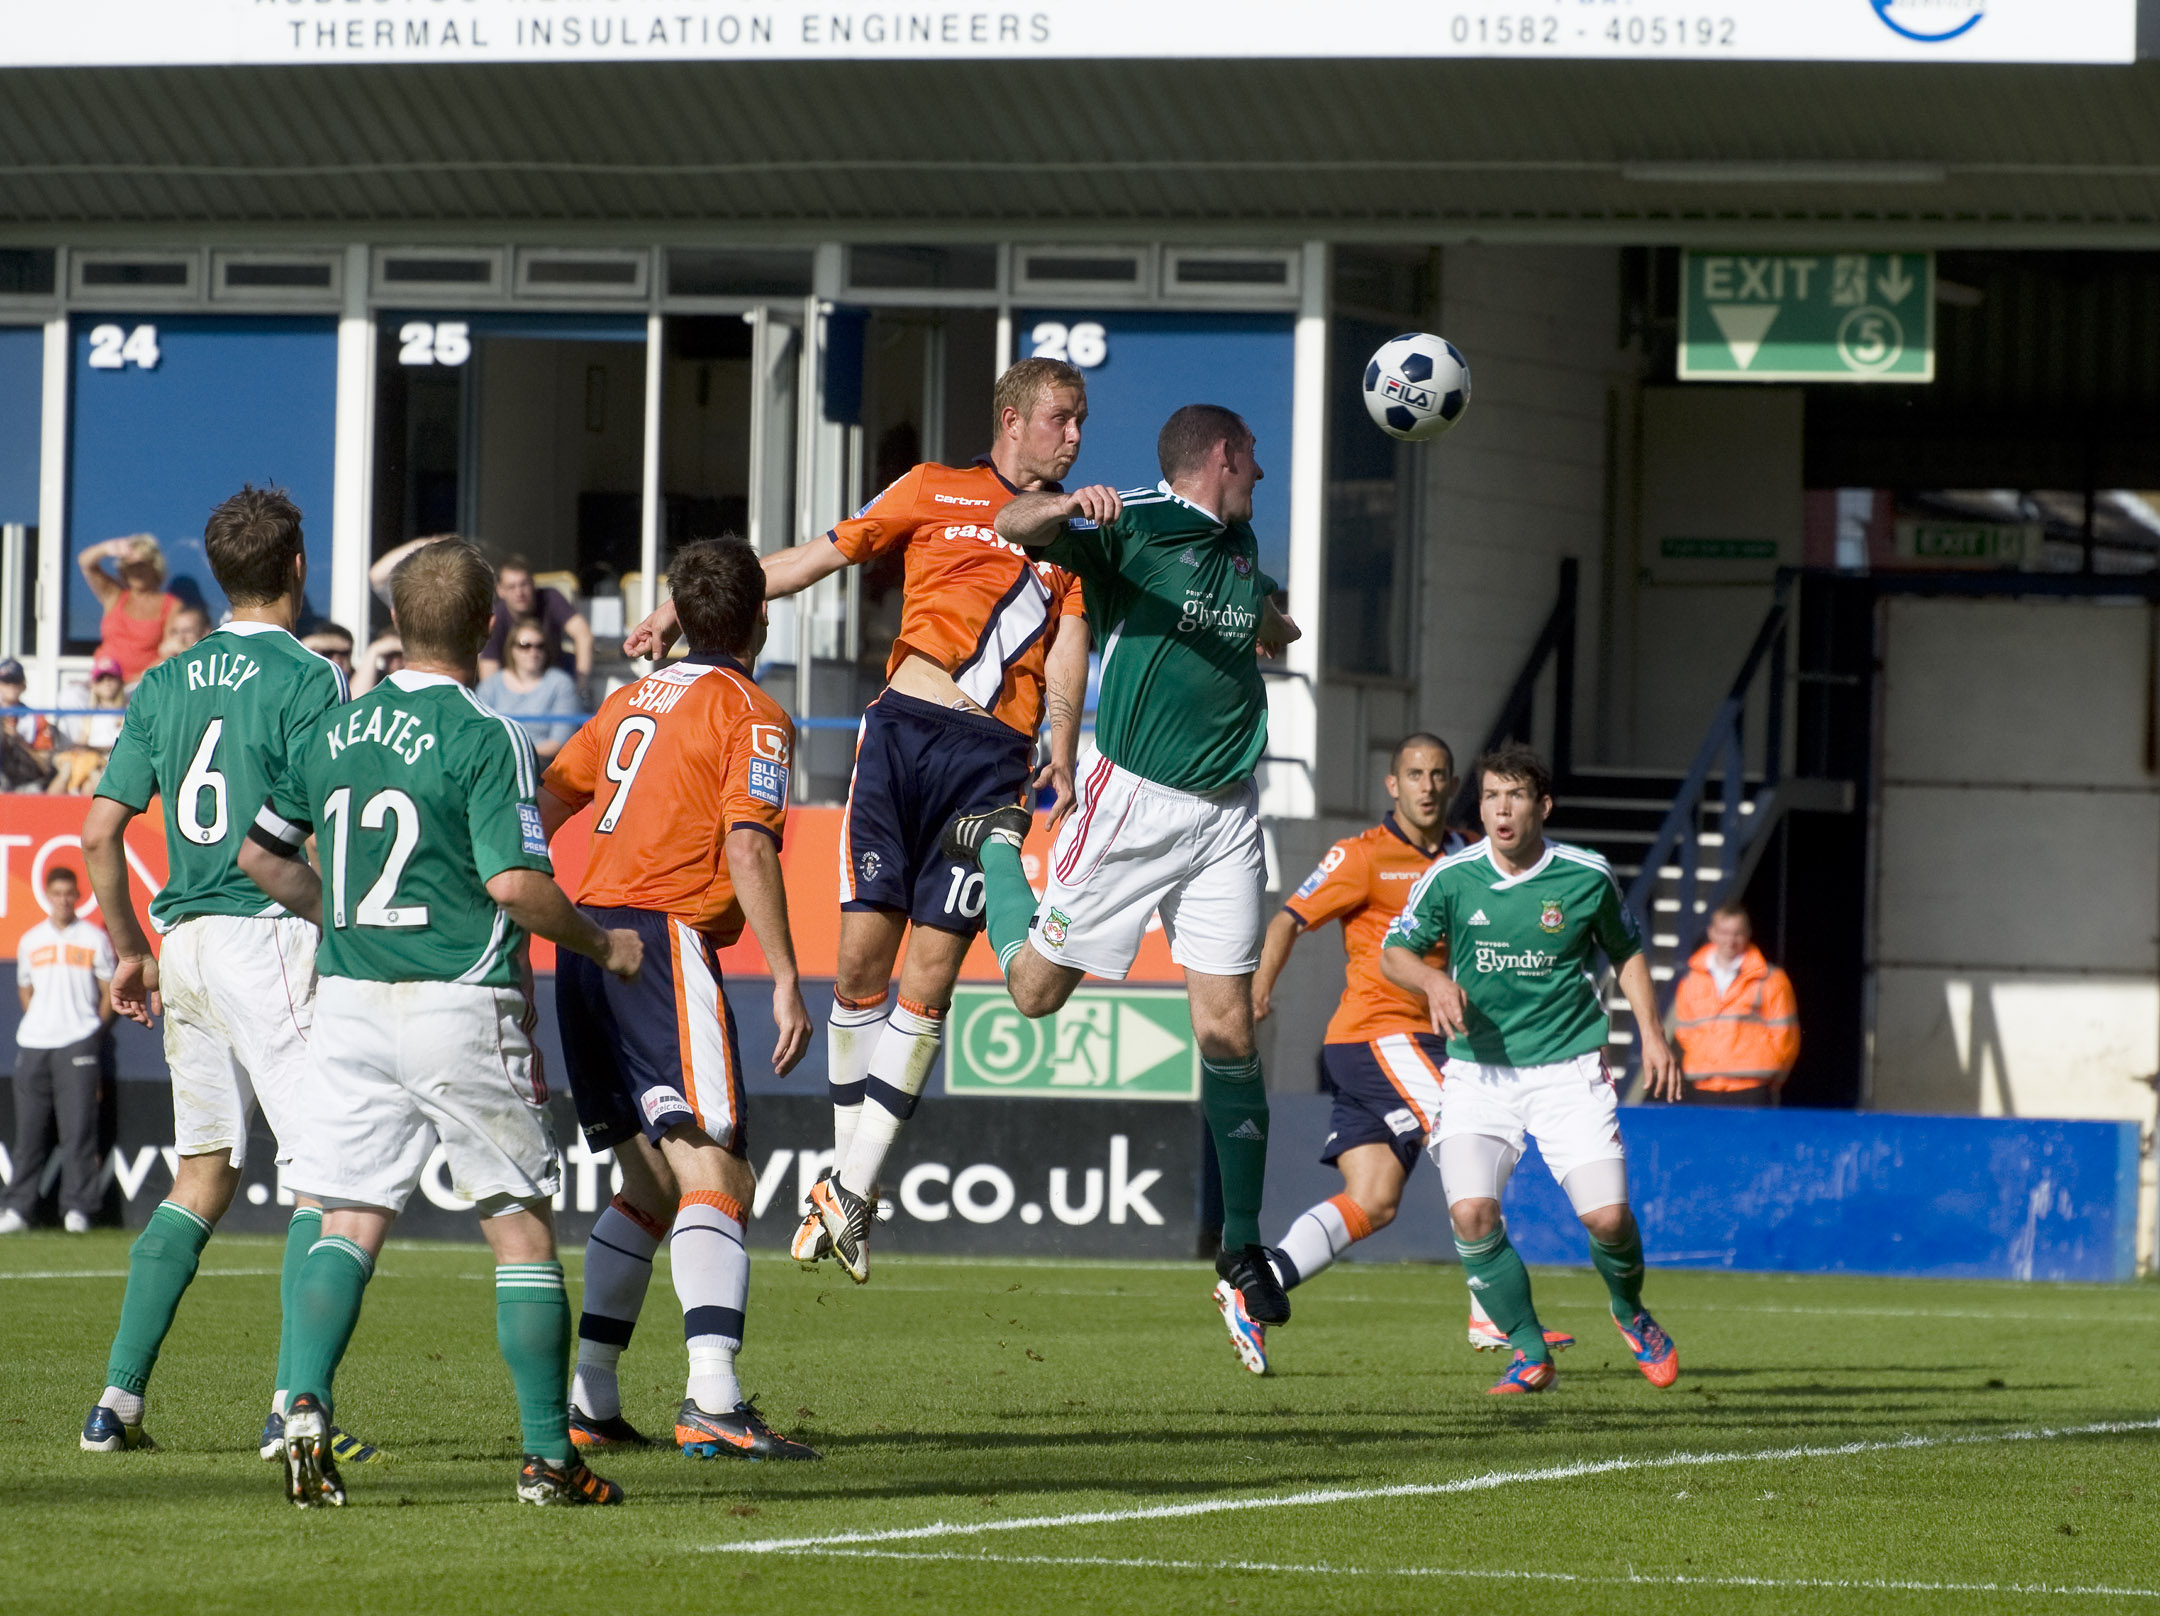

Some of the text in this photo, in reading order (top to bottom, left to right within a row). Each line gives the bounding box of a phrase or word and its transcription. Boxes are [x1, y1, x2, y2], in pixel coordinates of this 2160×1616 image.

[288, 14, 1051, 49] THERMAL INSULATION ENGINEERS
[1450, 15, 1559, 45] 01582
[1605, 16, 1738, 46] 405192
[1704, 259, 1819, 300] EXIT
[88, 324, 161, 369] 24
[398, 321, 471, 365] 25
[1031, 322, 1107, 368] 26
[1855, 320, 1885, 362] 5
[1386, 380, 1429, 408] FILA
[187, 653, 260, 692] RILEY
[629, 680, 690, 714] SHAW
[326, 706, 436, 766] KEATES
[176, 716, 229, 847] 6
[594, 714, 657, 834] 9
[323, 785, 431, 930] 12
[944, 866, 986, 918] 10
[1475, 947, 1557, 973] glyndŵr
[985, 1016, 1022, 1068] 5
